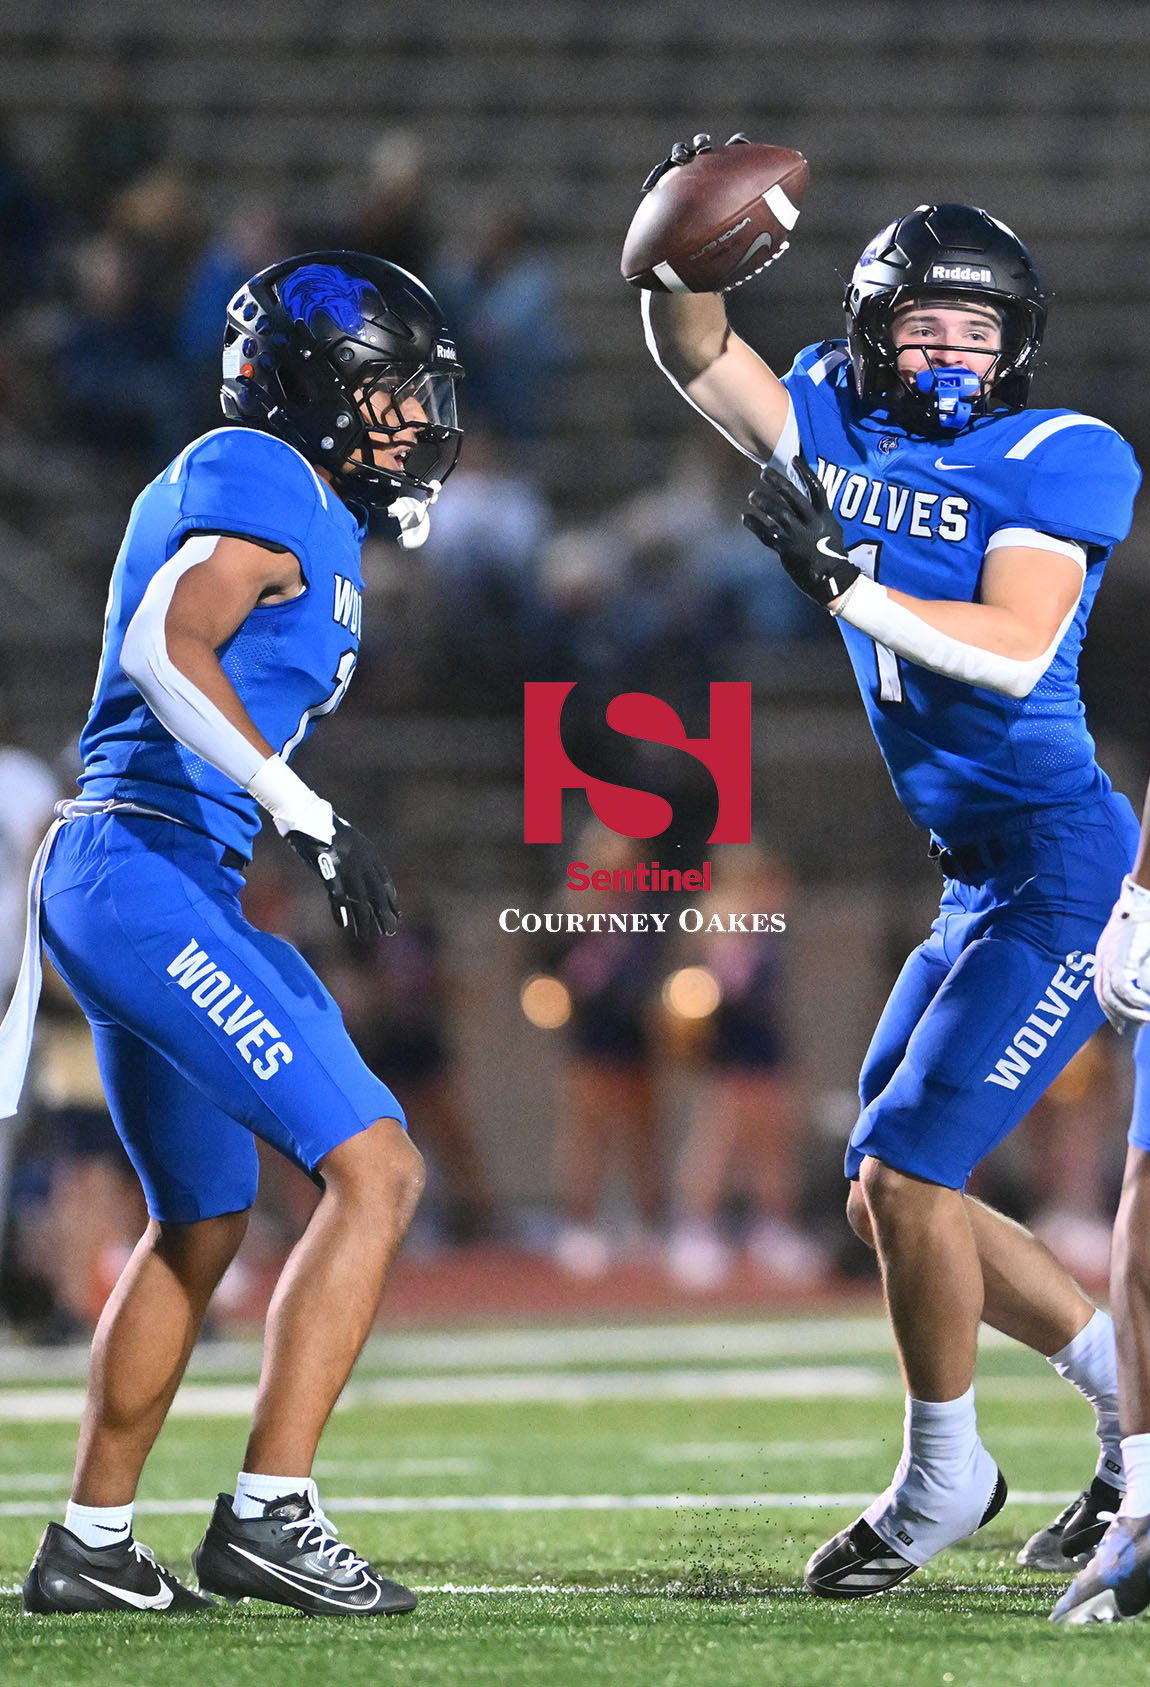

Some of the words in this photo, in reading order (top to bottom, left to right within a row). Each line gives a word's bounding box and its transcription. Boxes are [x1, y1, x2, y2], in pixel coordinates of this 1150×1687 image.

[932, 265, 992, 283] Riddell
[817, 456, 970, 543] WOLVES
[847, 540, 904, 703] 1
[166, 937, 294, 1081] WOLVES
[983, 950, 1098, 1091] WOLVES
